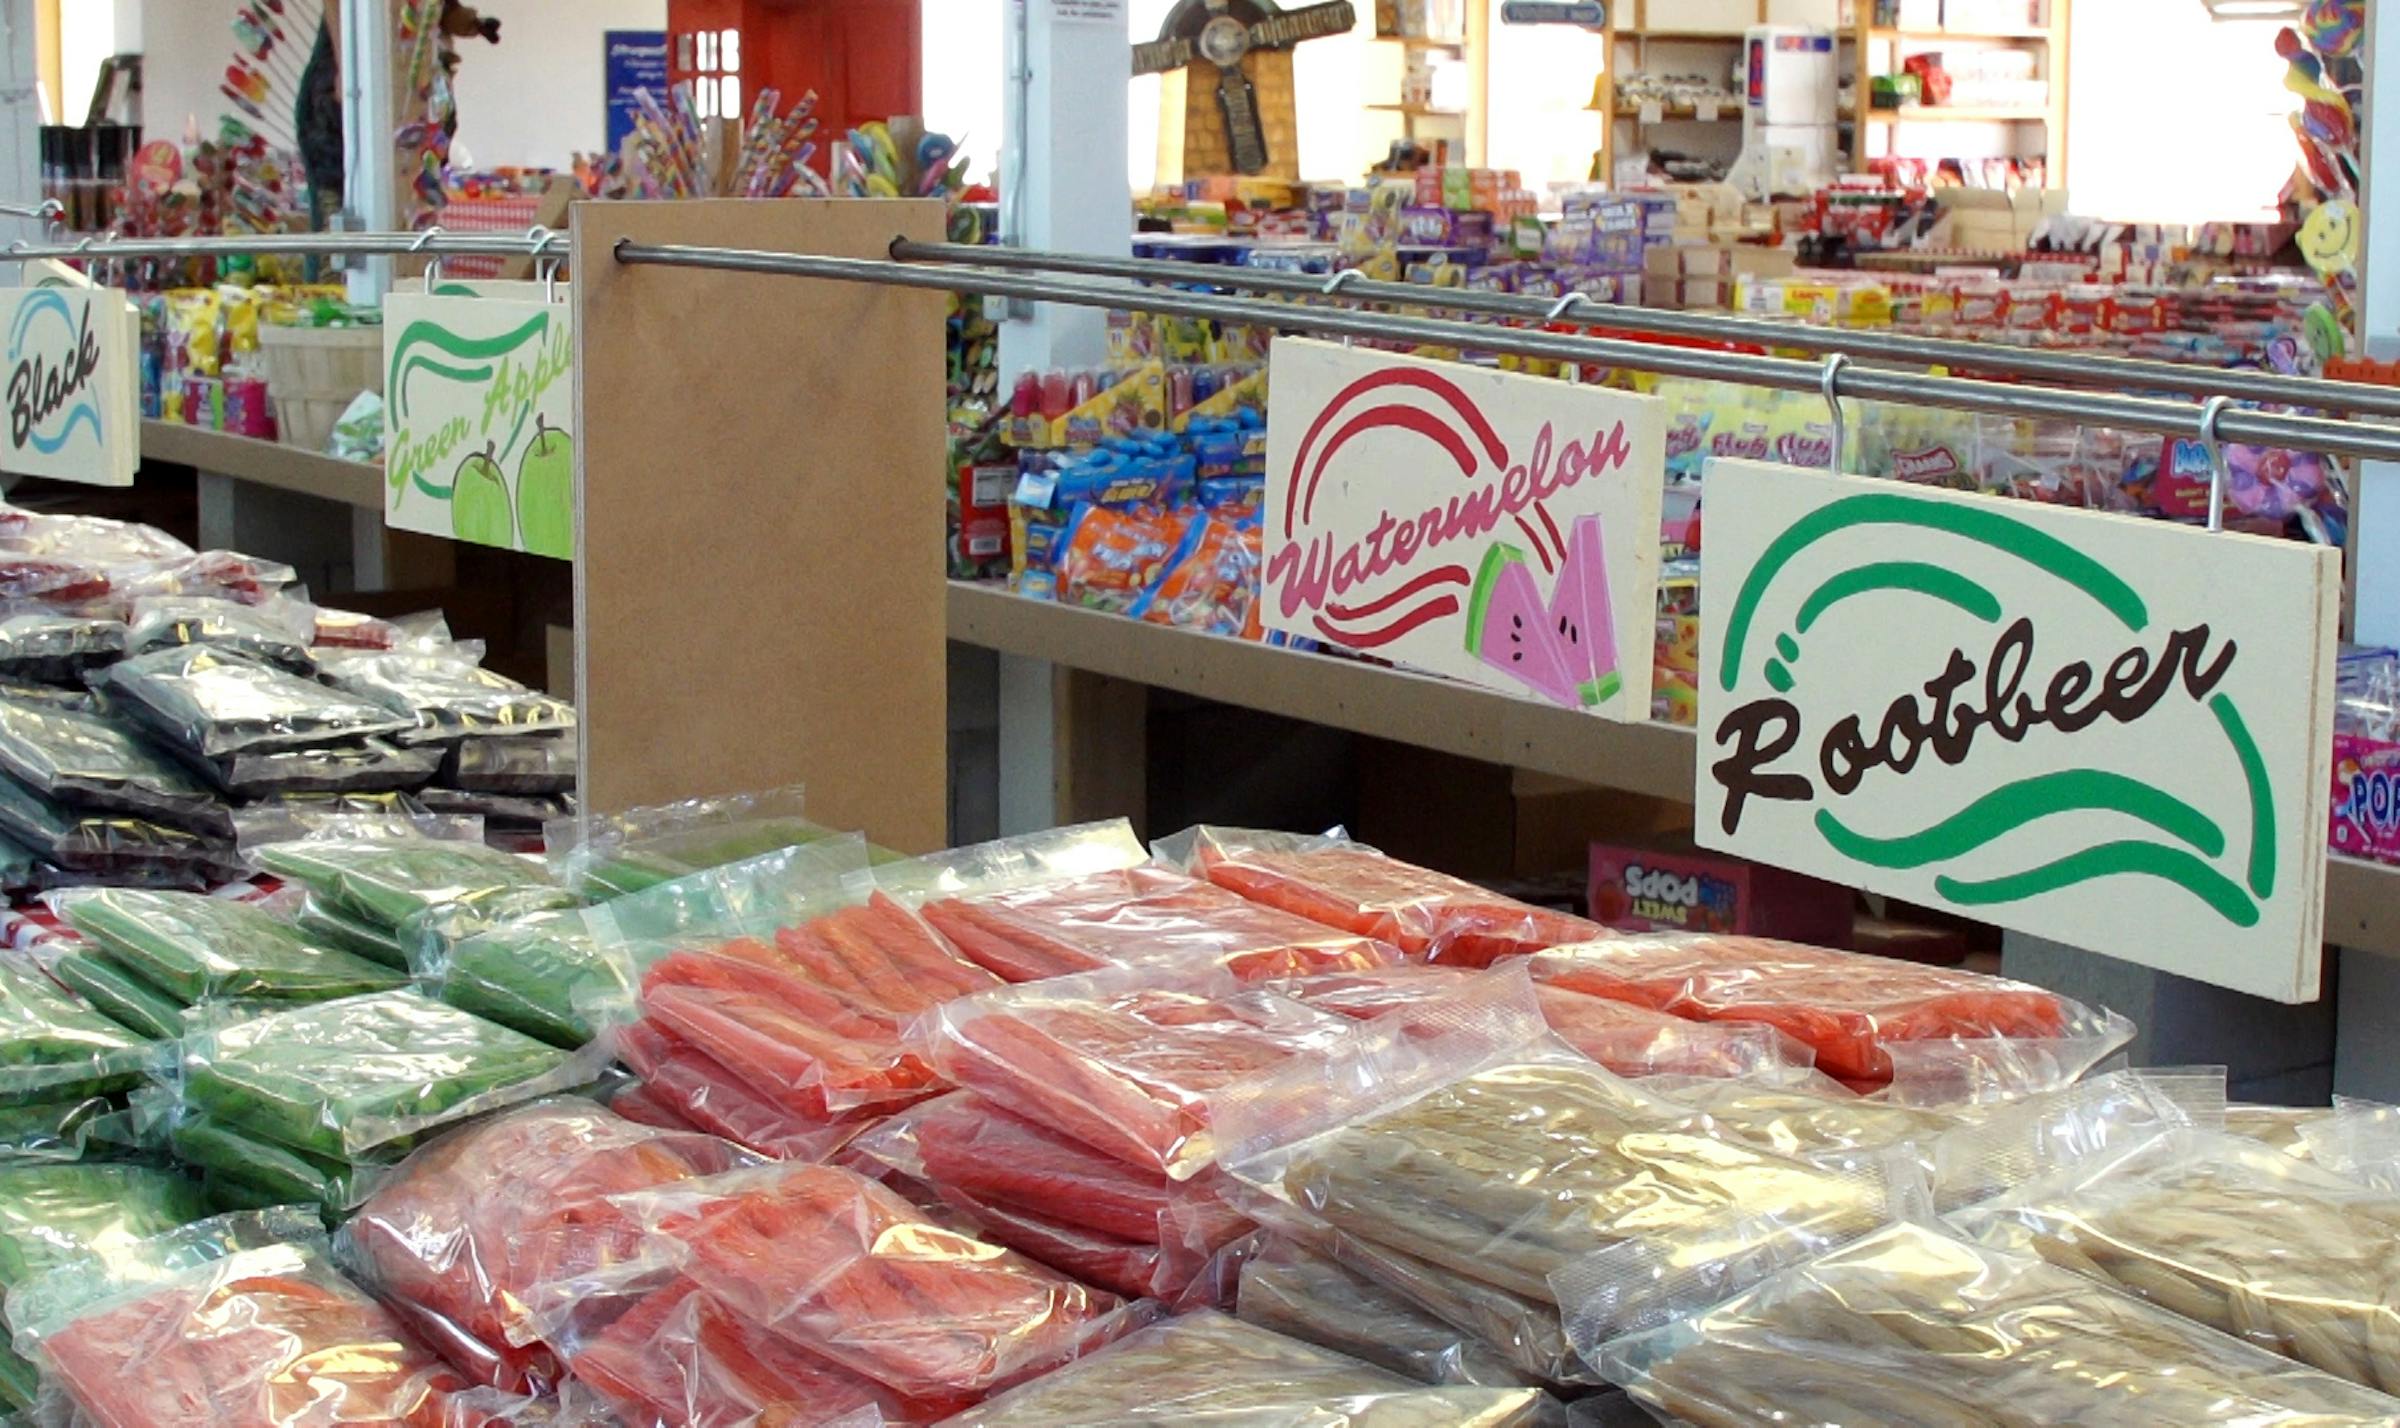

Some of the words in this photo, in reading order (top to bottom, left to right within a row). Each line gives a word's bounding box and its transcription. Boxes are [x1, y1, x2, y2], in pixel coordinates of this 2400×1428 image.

[7, 298, 100, 449] Black
[388, 415, 471, 510] Green
[1266, 420, 1631, 618] Watermelon
[1711, 617, 2237, 835] Rootbeer
[1625, 865, 1698, 907] POPS
